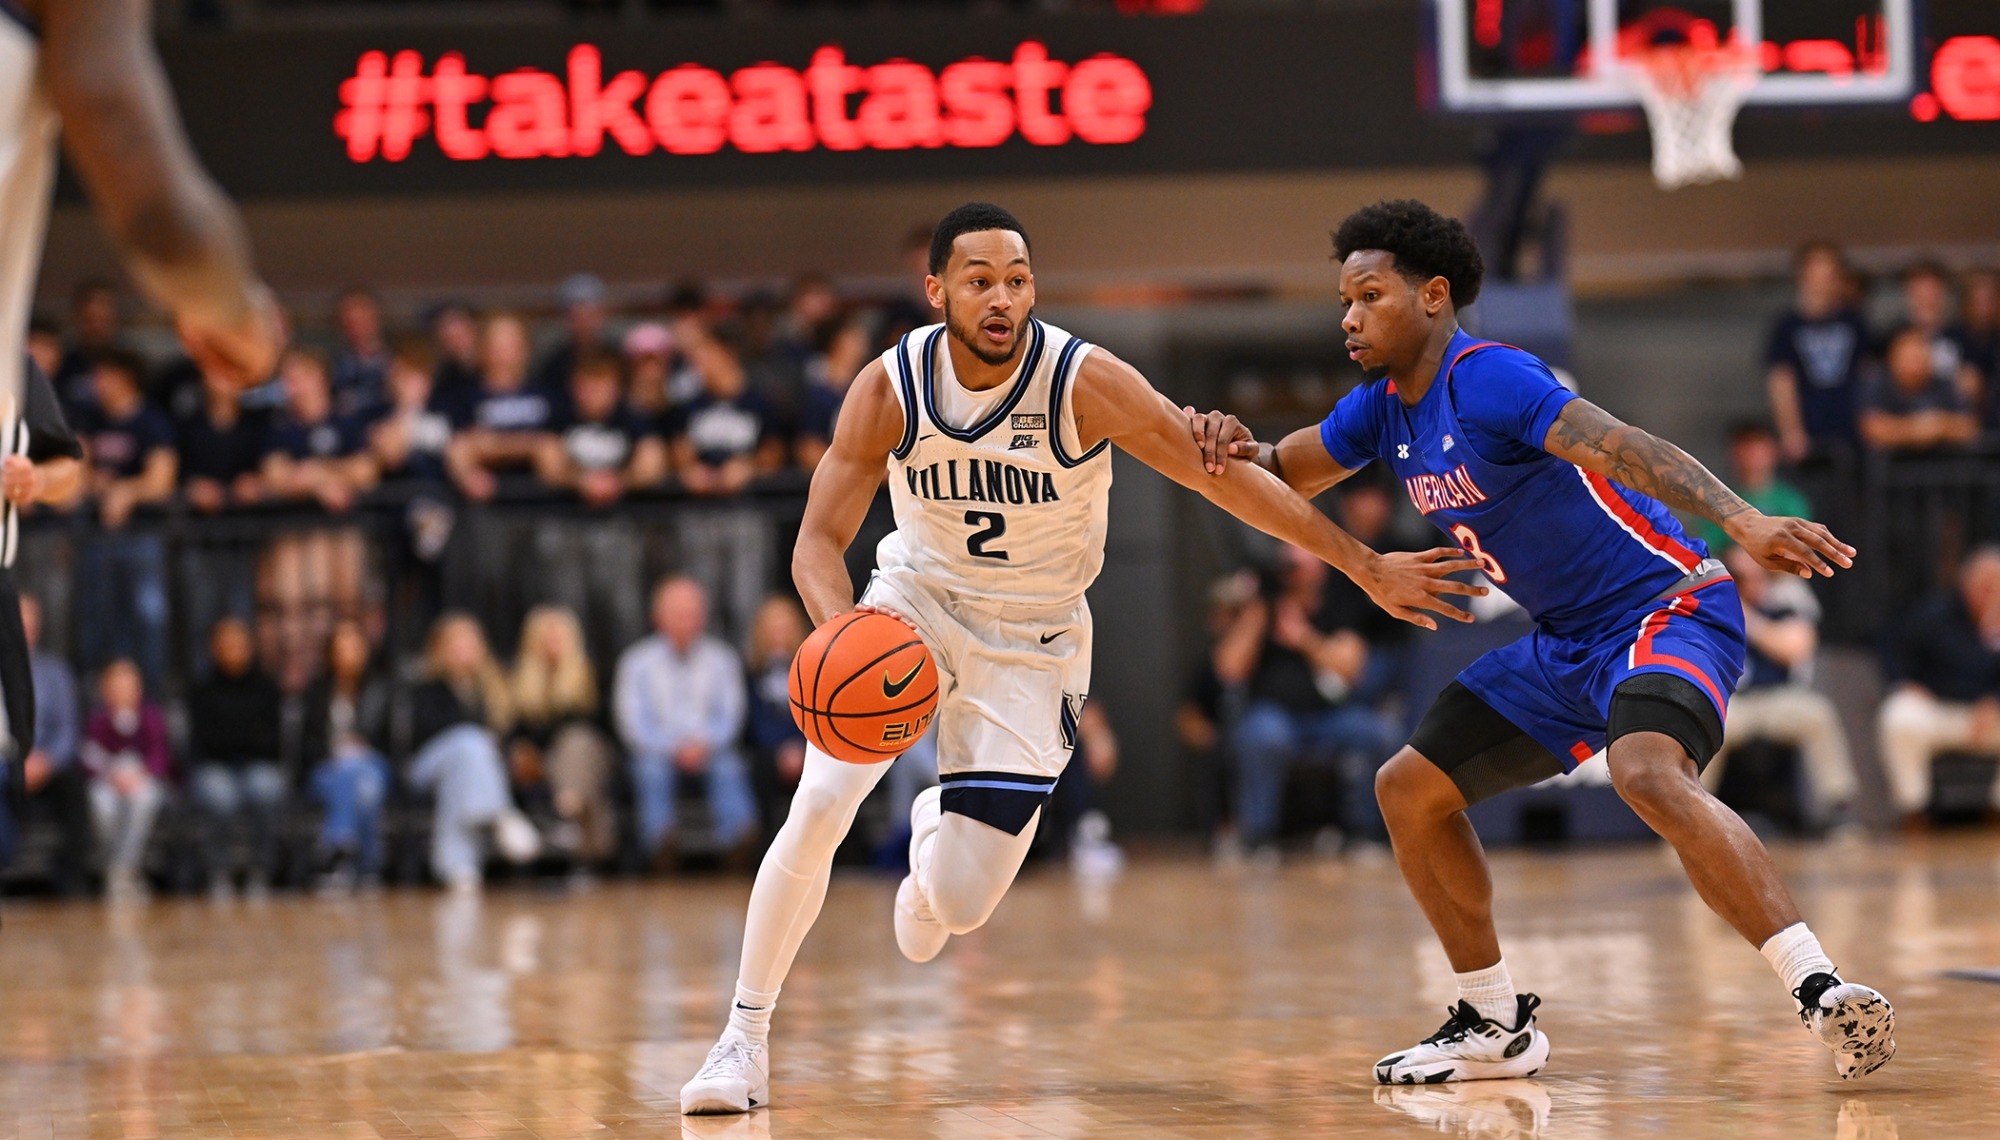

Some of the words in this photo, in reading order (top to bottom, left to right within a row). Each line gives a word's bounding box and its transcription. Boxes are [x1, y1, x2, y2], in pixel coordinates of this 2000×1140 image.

[335, 40, 1152, 162] #takeataste
[906, 458, 1061, 505] VILLANOVA
[1405, 463, 1488, 516] AMERICAN
[964, 510, 1010, 561] 2
